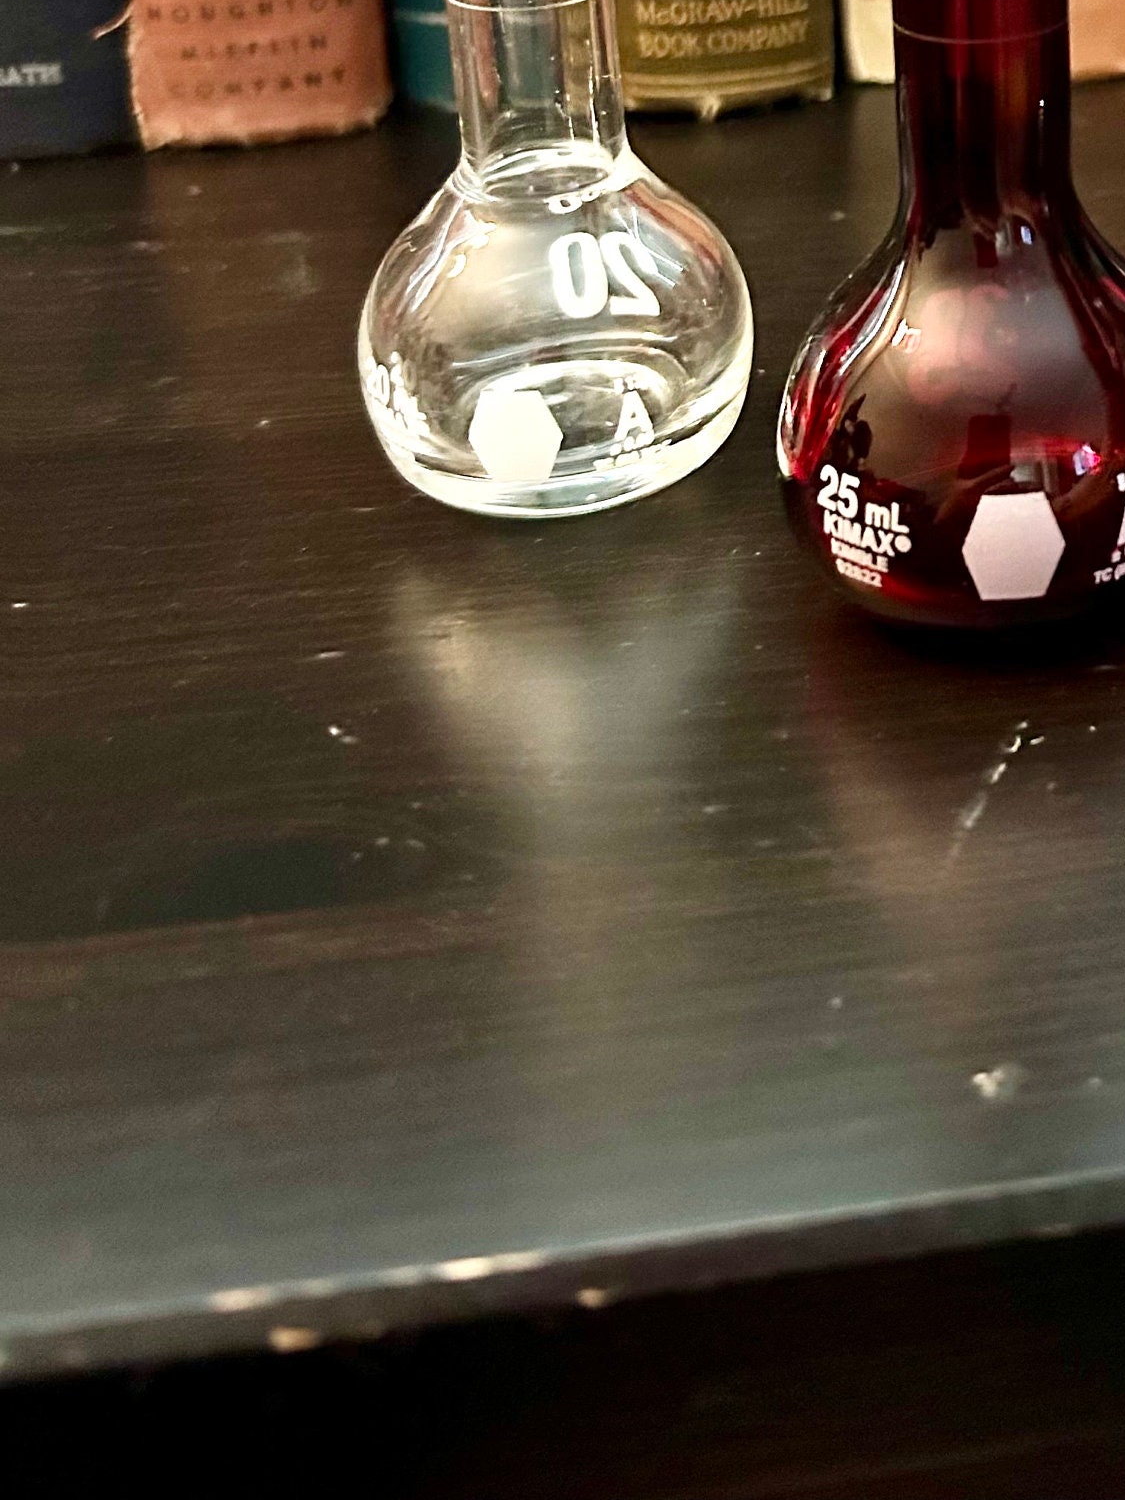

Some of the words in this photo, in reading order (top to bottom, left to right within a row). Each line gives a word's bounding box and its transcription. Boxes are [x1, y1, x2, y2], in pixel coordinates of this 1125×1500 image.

[816, 463, 861, 519] 25
[864, 501, 911, 534] mL
[823, 508, 896, 558] KIMAX
